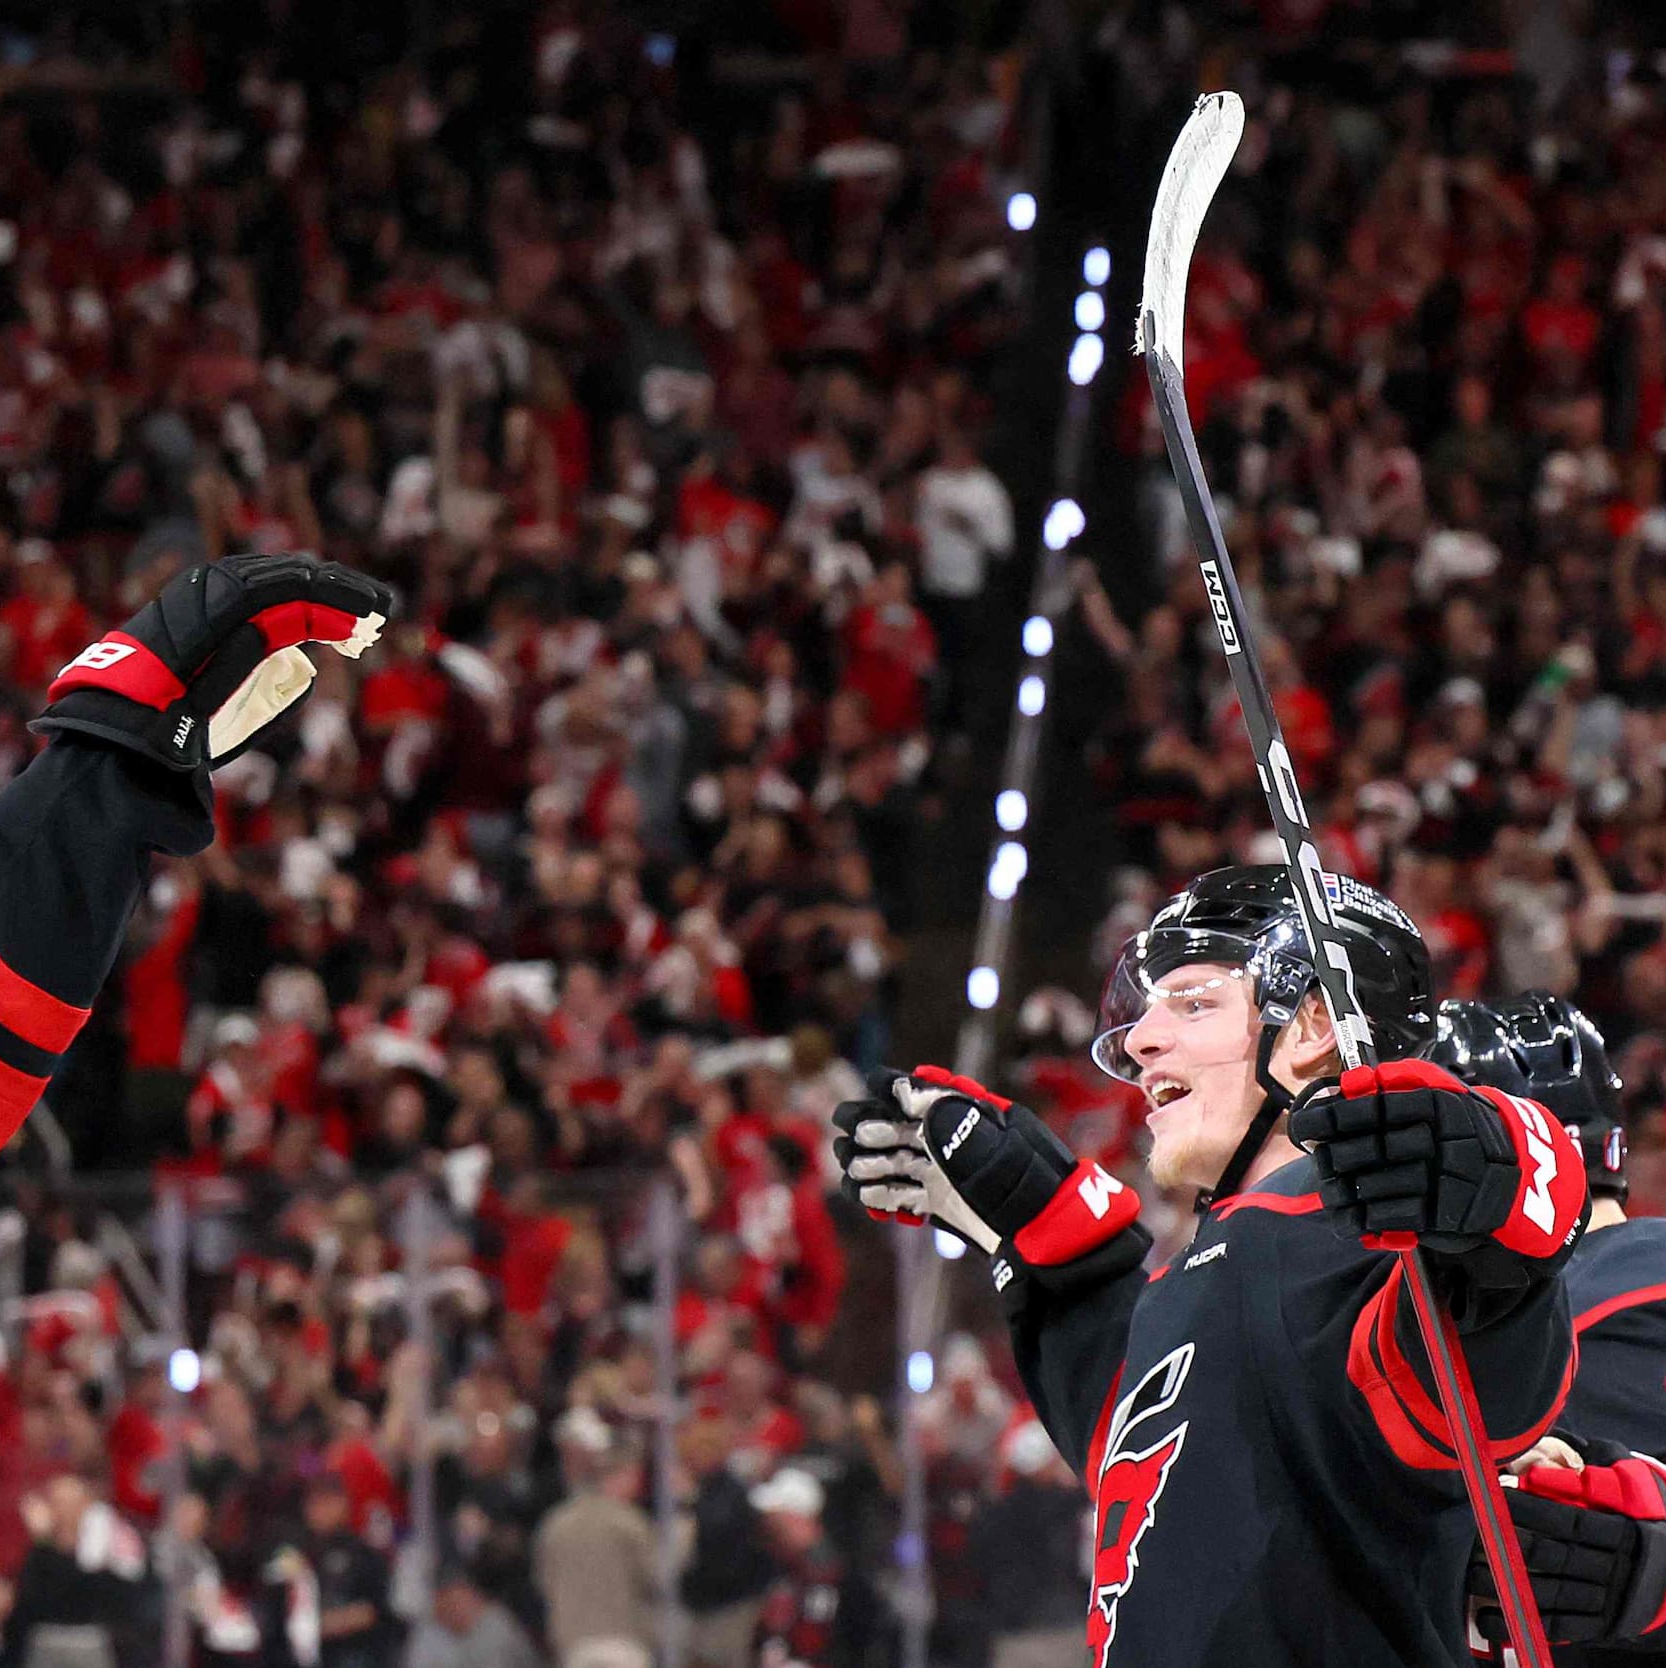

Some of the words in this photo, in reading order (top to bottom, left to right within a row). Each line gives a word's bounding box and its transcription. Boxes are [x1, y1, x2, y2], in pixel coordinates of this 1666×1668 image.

[1203, 569, 1236, 646] CCM
[172, 714, 195, 749] HALL
[942, 1106, 982, 1161] CCM
[1503, 1091, 1558, 1236] CM
